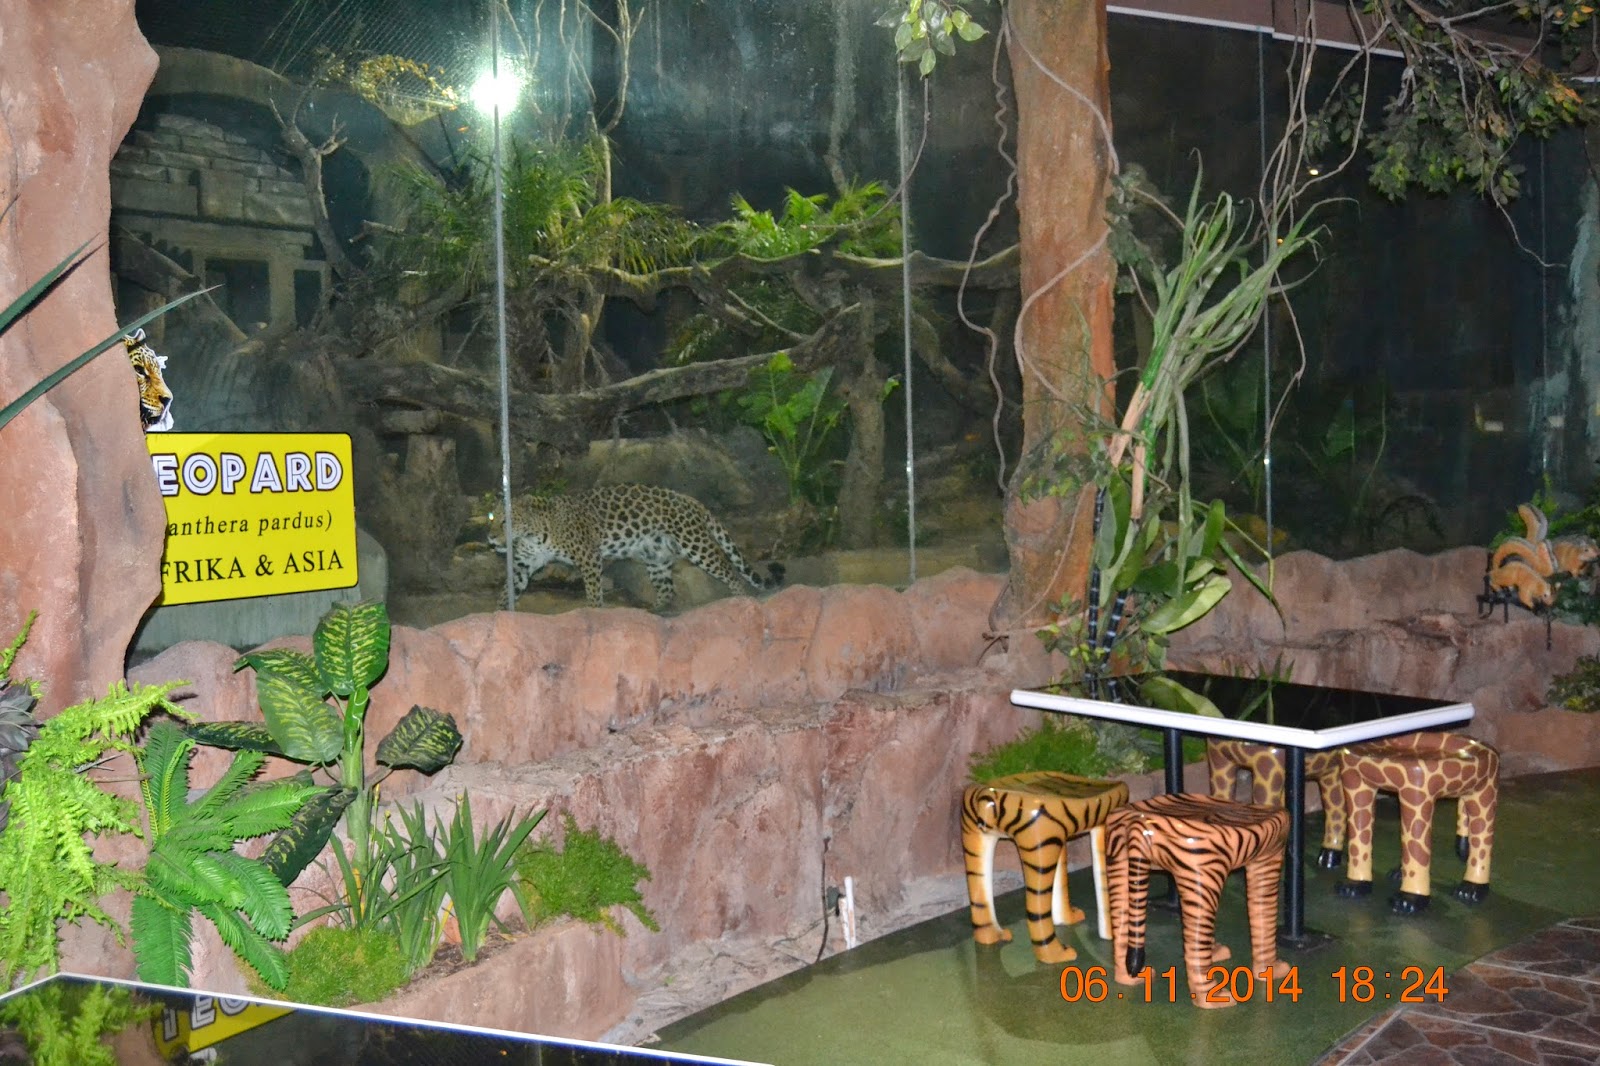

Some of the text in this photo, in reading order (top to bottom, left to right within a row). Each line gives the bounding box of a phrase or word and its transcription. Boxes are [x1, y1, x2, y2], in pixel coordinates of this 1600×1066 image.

[151, 451, 343, 496] EOPARD
[167, 510, 332, 537] anthera pardus)
[161, 549, 344, 584] FRIKA & ASIA
